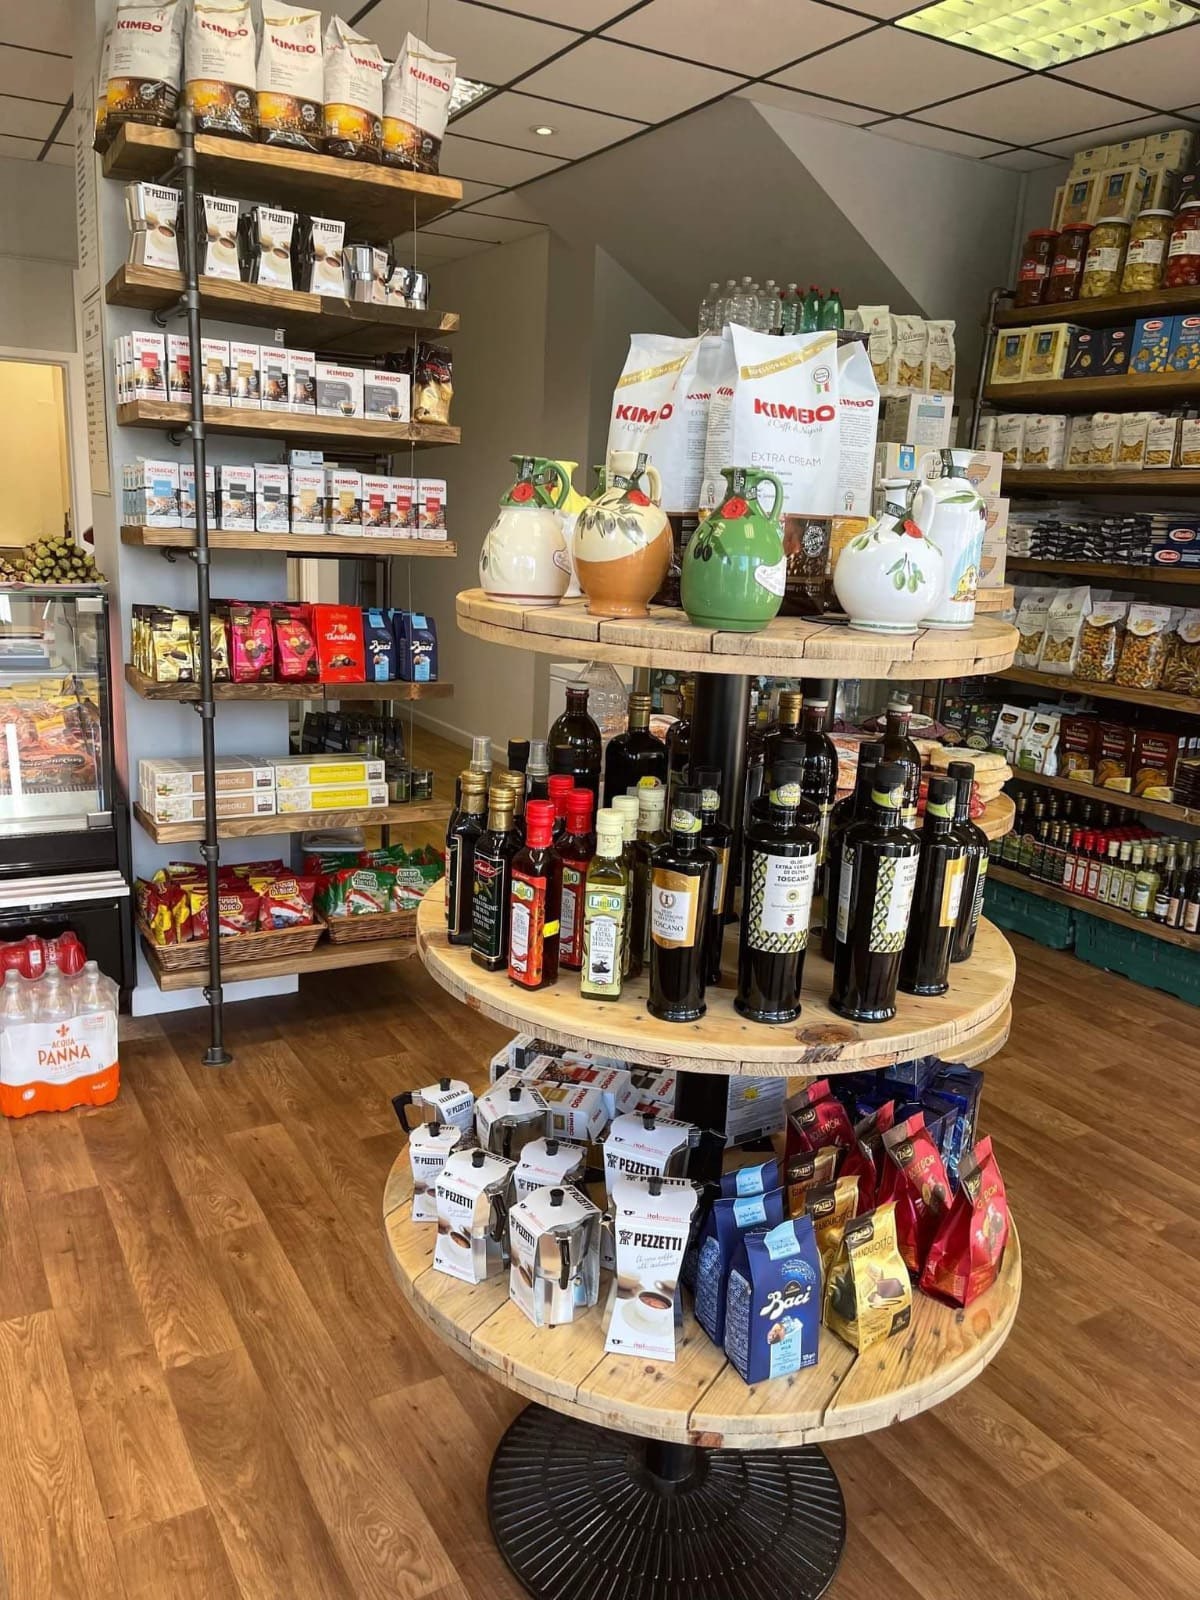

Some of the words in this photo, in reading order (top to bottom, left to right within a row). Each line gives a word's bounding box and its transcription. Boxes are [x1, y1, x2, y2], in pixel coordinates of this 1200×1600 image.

[117, 20, 163, 33] KIMBO
[271, 35, 316, 54] KIMBO
[353, 56, 383, 73] IMBO
[409, 66, 450, 92] KIMBO
[152, 188, 177, 201] PEZZETTI
[213, 201, 237, 214] PEZZETTI
[268, 212, 292, 225] PEZZETTI
[320, 221, 343, 233] PEZZETTI
[327, 369, 354, 378] KIMBO
[375, 374, 401, 383] KIMBO
[616, 403, 673, 424] KIMO
[754, 398, 836, 424] KIMBO
[752, 452, 785, 463] EXTRA
[788, 456, 822, 466] CREAM
[52, 1039, 75, 1048] ACQUA
[38, 1046, 91, 1066] PANNA
[601, 1070, 618, 1090] KIMBO
[658, 1078, 675, 1097] KIMBO
[452, 1100, 471, 1114] PEZZETTI
[571, 1088, 589, 1108] KIMBO
[421, 1157, 444, 1165] PEZZETTI
[619, 1157, 660, 1177] PEZZETTI
[445, 1190, 473, 1209] PEZZETTI
[515, 1219, 535, 1248] PEZZETTI
[634, 1233, 682, 1251] PEZZETTI
[760, 1286, 812, 1320] Baci
